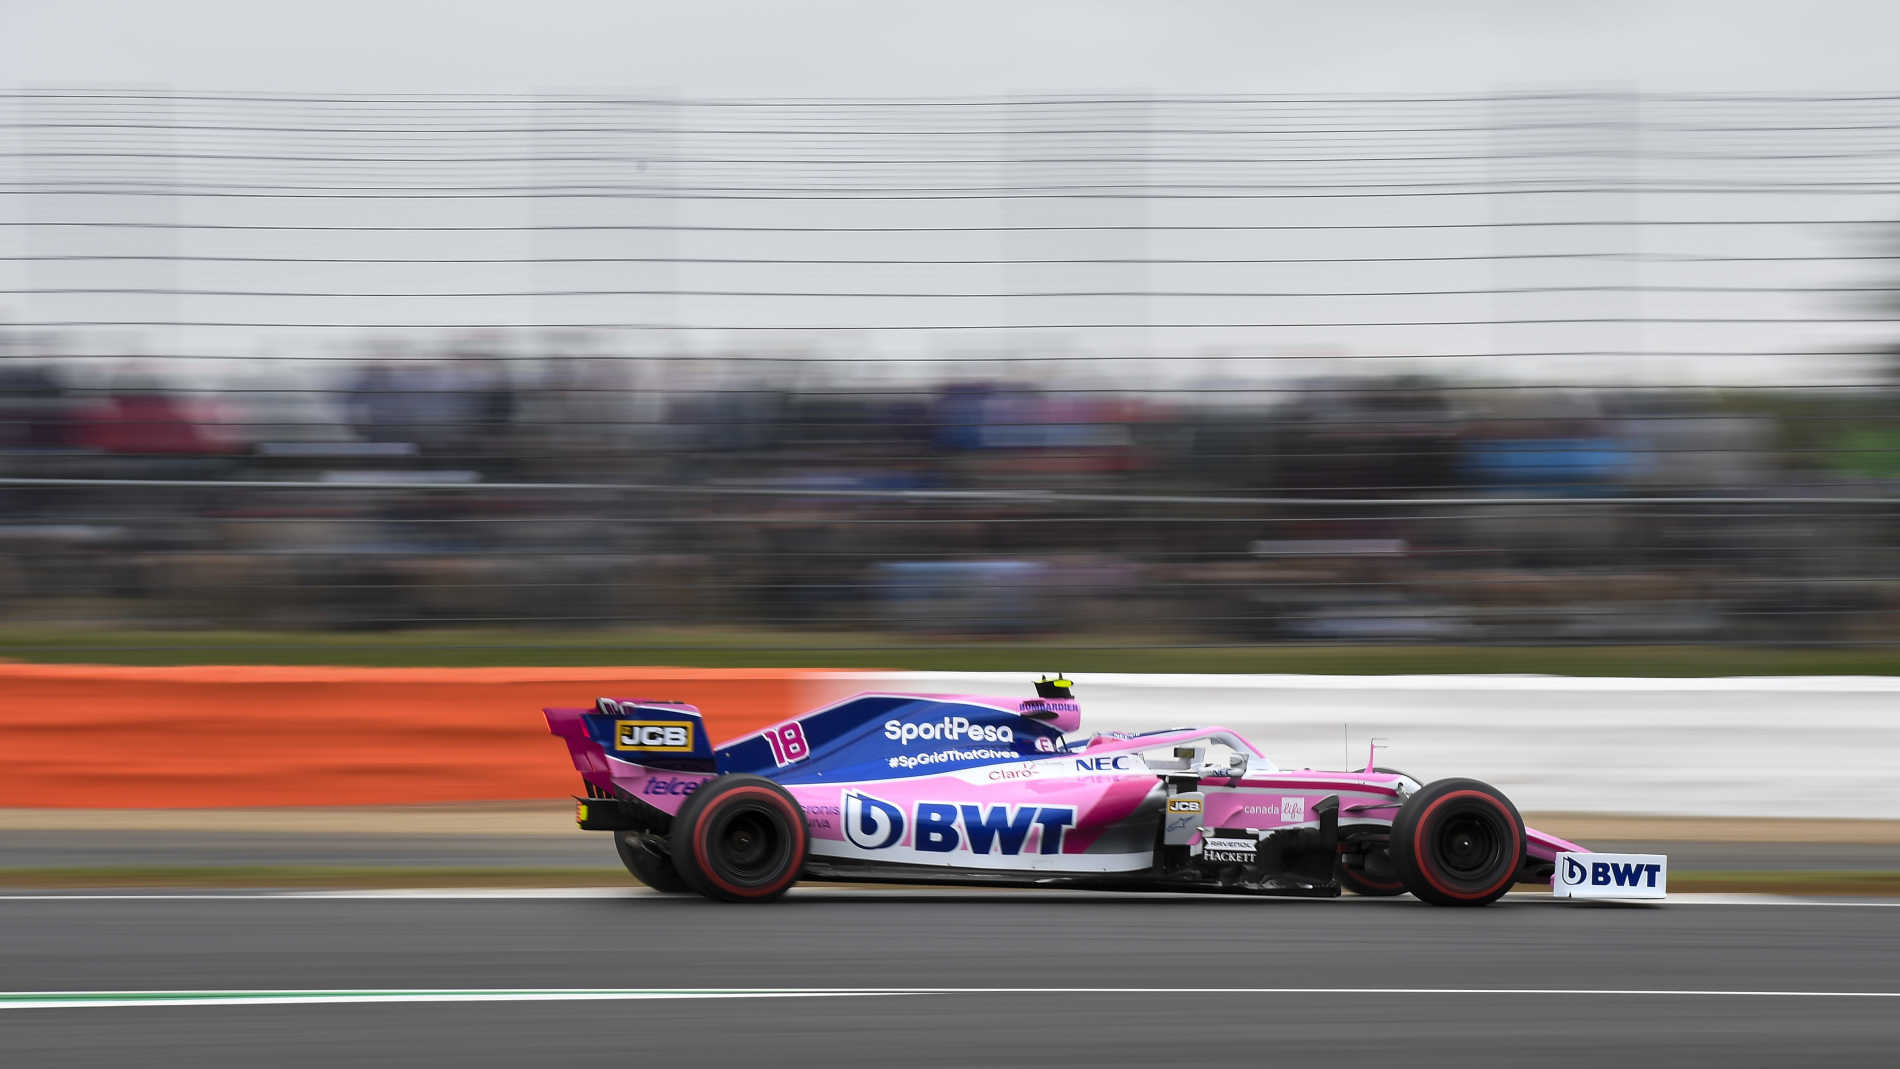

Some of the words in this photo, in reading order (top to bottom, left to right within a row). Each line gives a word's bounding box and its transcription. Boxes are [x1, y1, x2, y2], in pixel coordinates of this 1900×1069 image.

[620, 725, 687, 746] JCB
[884, 716, 1014, 745] SportPesa
[763, 720, 810, 768] 18
[889, 748, 1020, 769] #SpGridThatGives
[1076, 756, 1130, 772] NEC
[1170, 801, 1200, 812] JCB
[1244, 804, 1280, 815] canada
[1283, 800, 1303, 819] life
[913, 800, 1077, 855] BWT
[1203, 849, 1257, 863] HACKETT
[1591, 862, 1661, 888] BWT
